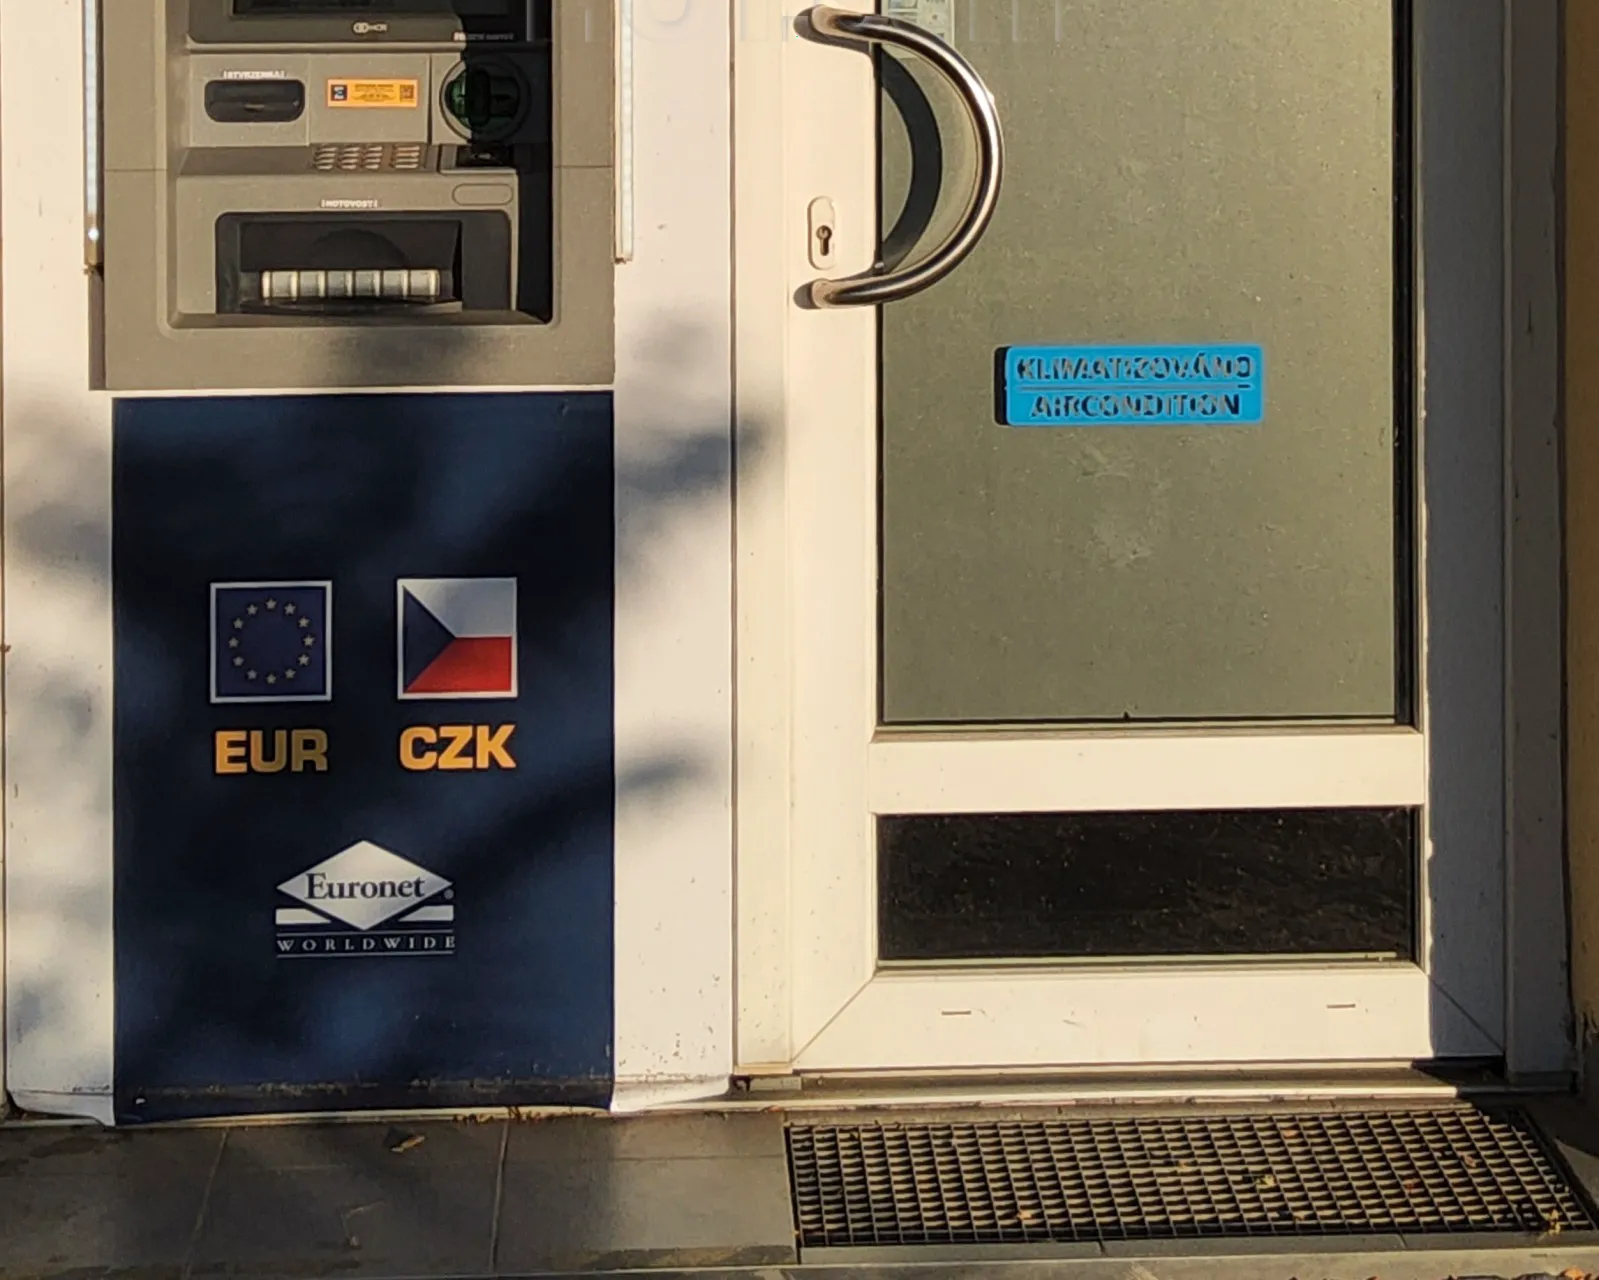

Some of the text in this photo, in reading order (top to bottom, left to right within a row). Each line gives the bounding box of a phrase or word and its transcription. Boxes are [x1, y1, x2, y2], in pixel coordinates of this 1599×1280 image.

[1031, 393, 1241, 417] AIRCONDITION
[214, 729, 329, 774] EUR
[399, 724, 517, 771] CZK
[305, 872, 425, 900] Euronet
[277, 935, 456, 952] WORLDWIDE
